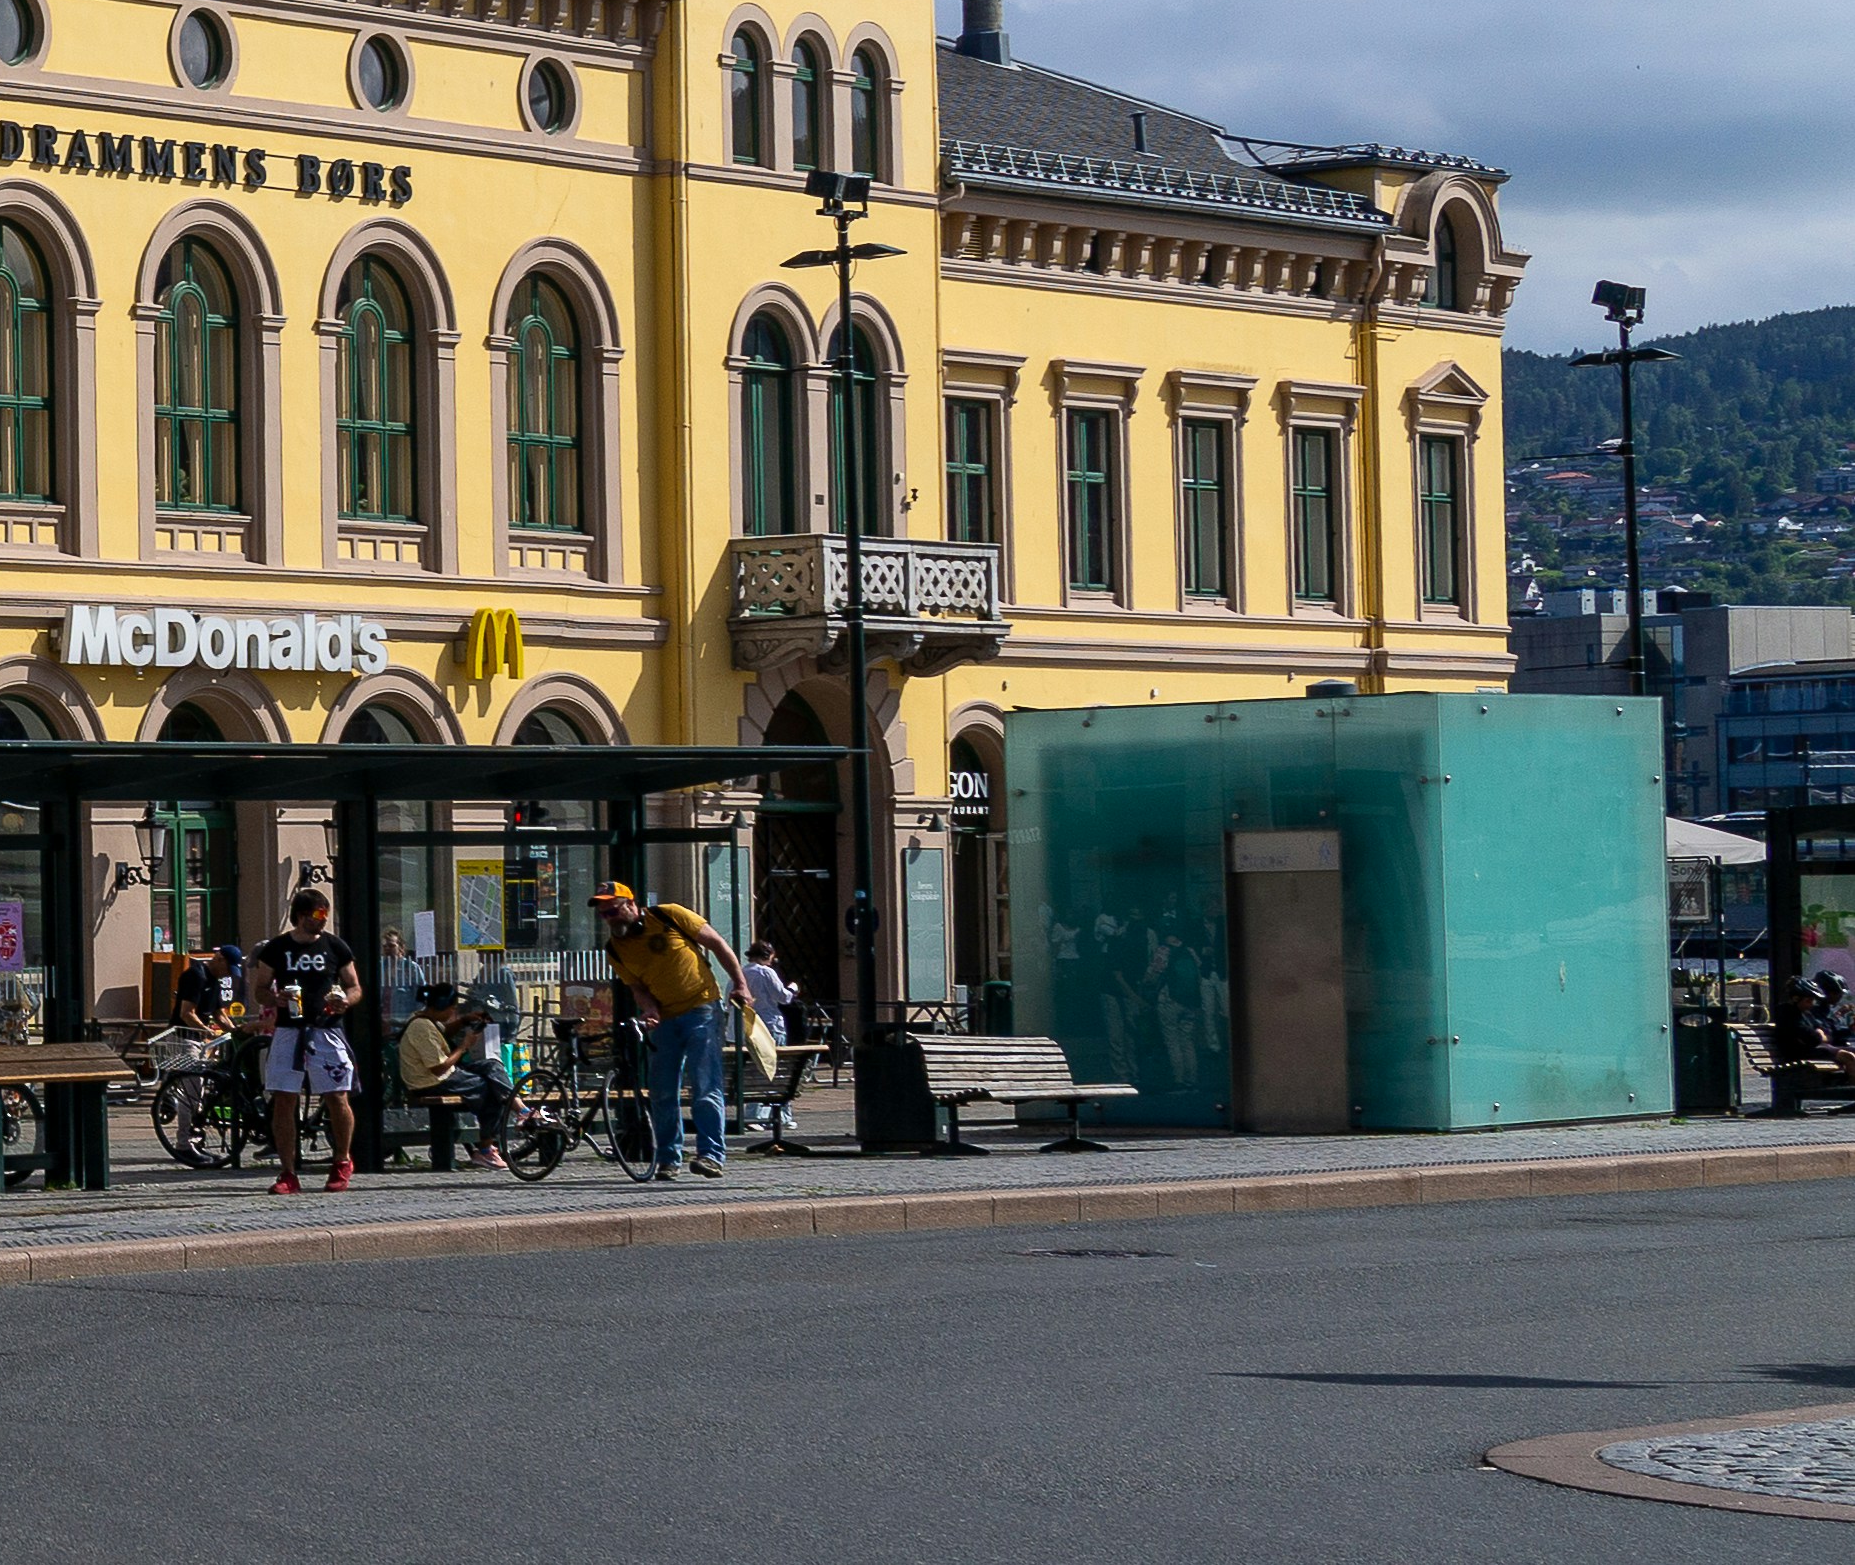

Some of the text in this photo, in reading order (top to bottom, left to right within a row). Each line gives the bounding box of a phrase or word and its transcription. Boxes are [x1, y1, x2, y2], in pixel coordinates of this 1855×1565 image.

[295, 153, 413, 203] BØRS
[64, 604, 389, 674] McDonald's
[950, 806, 989, 815] AURANT
[284, 951, 325, 971] Lee
